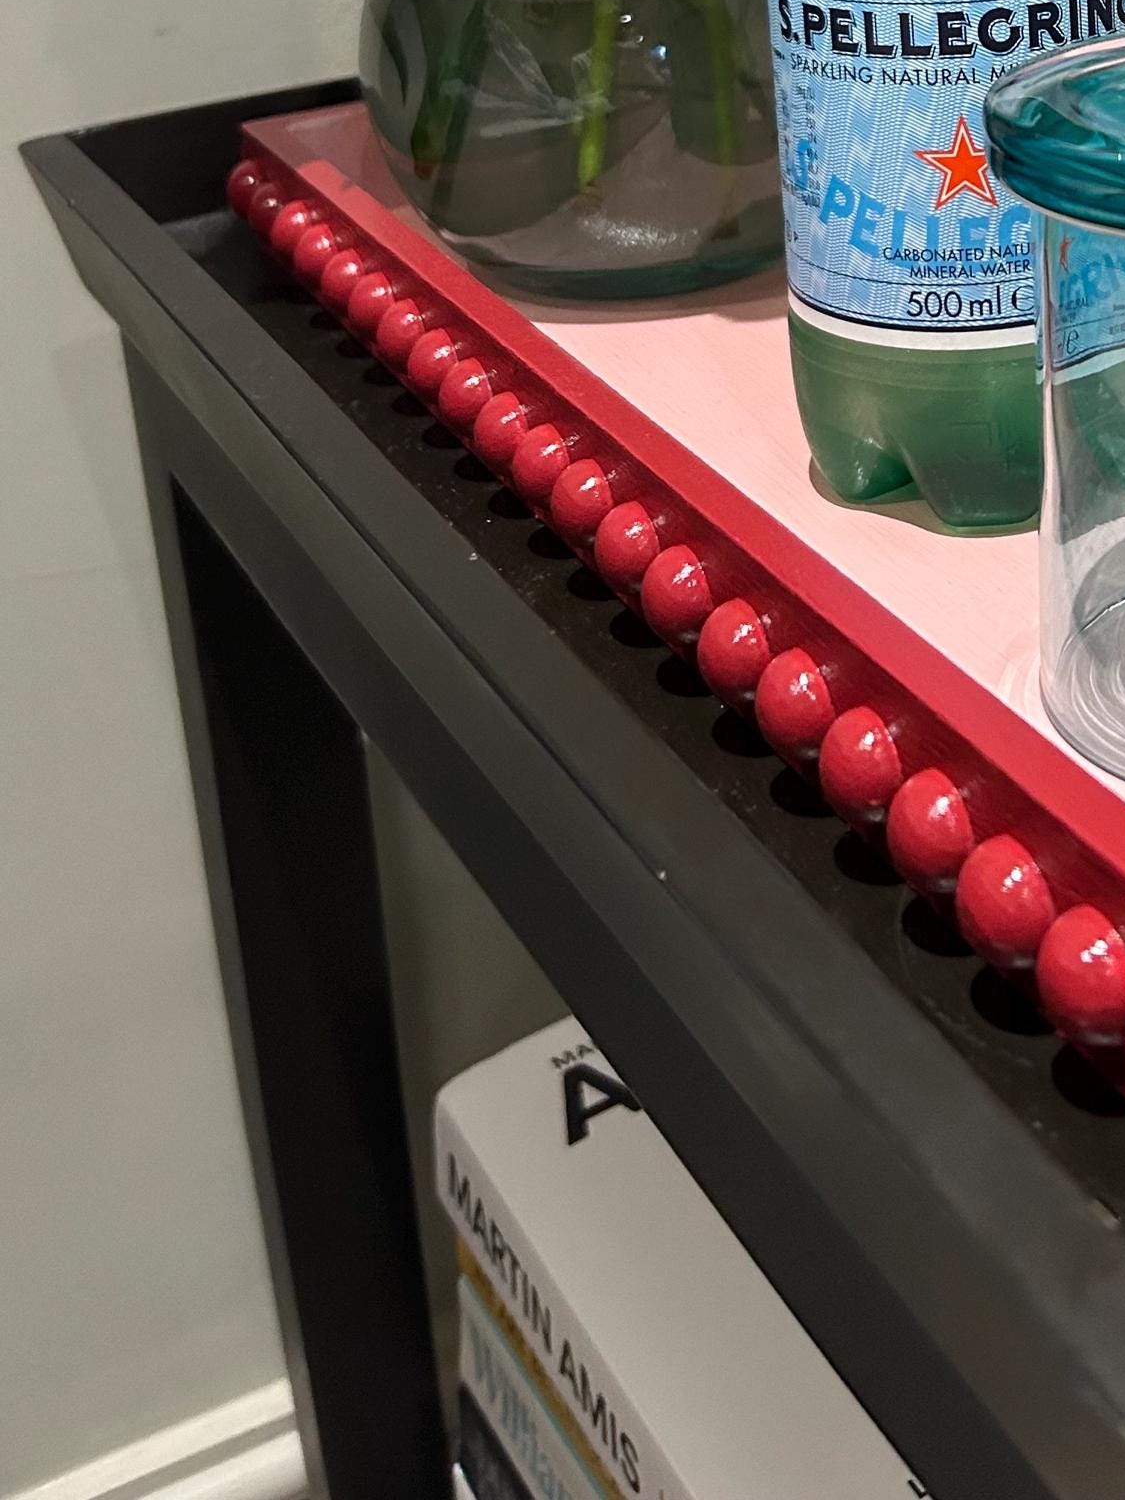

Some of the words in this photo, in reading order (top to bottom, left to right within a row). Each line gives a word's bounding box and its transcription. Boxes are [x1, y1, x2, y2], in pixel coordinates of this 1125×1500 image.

[791, 55, 873, 83] SPARKLING
[882, 67, 980, 85] NATURAL
[883, 246, 984, 264] CARBONATED
[909, 264, 976, 279] MINERAL
[982, 258, 1031, 277] WATER
[906, 291, 962, 318] 500
[969, 285, 1001, 317] ml
[449, 1152, 551, 1354] MARTIN
[559, 1338, 640, 1494] AMIS
